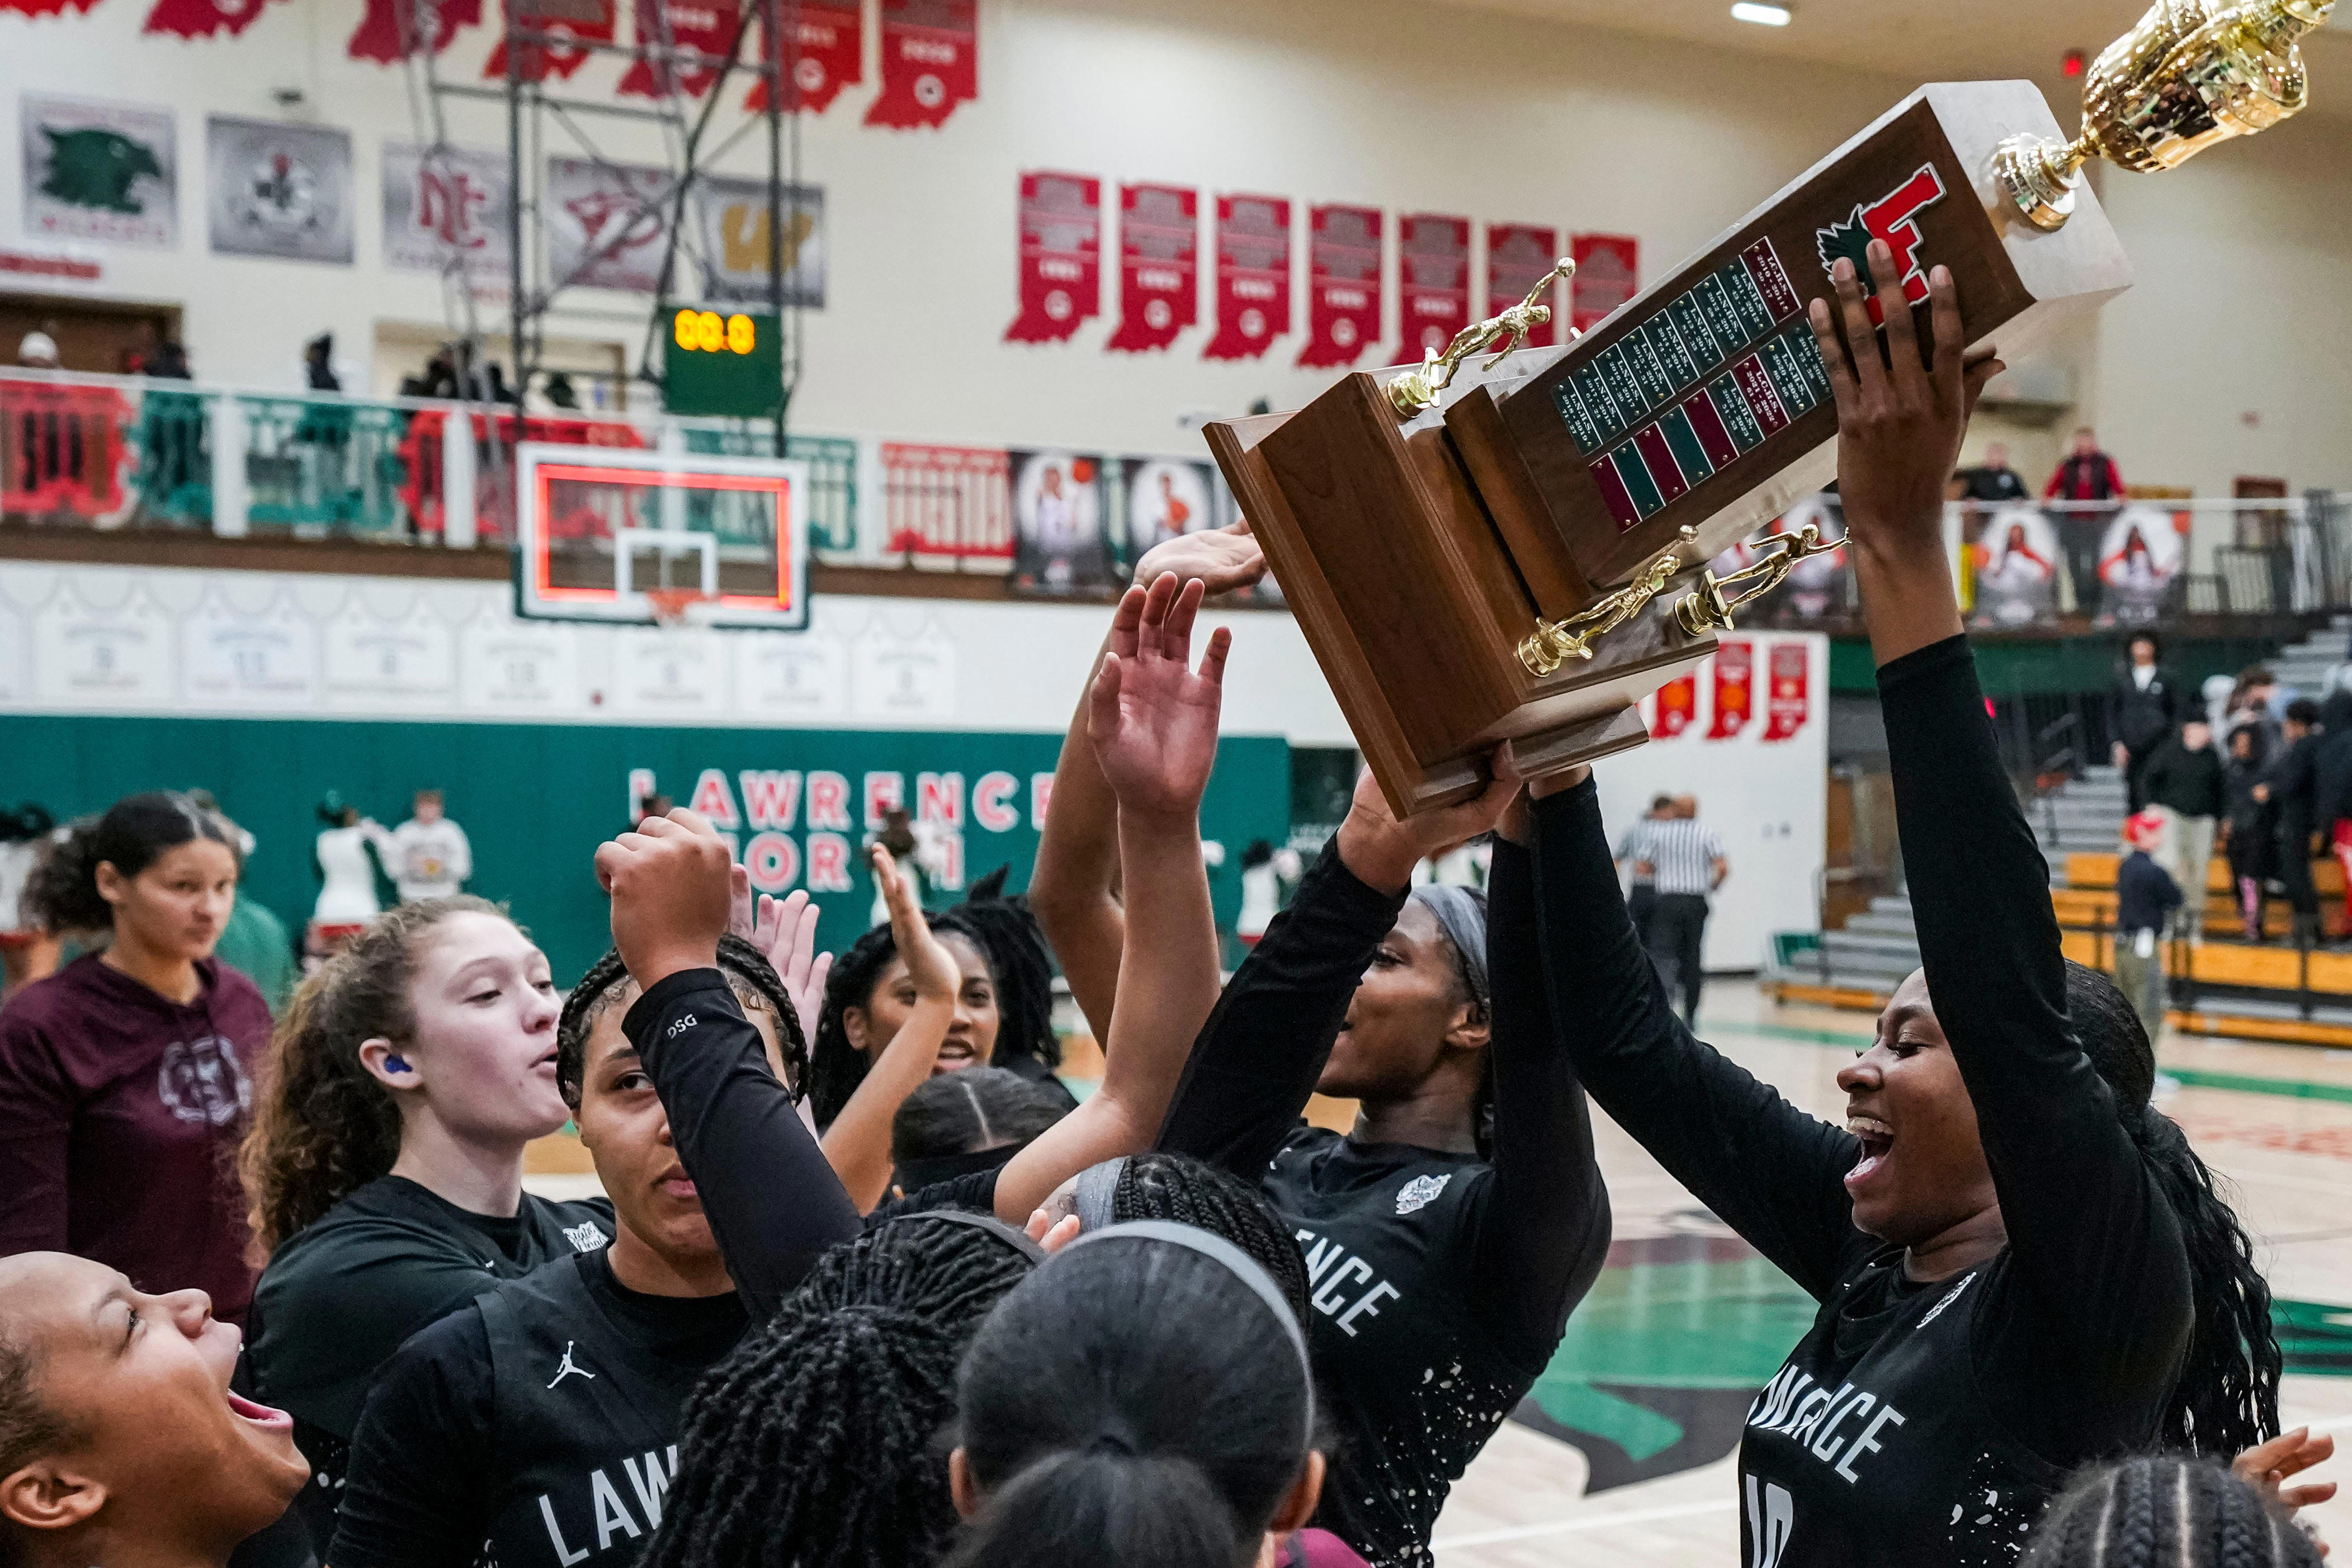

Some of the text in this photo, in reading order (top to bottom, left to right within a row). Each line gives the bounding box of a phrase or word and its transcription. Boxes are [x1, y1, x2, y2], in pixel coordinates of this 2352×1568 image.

[1732, 274, 1744, 293] 2011
[1745, 301, 1759, 323] 2012
[1757, 254, 1770, 277] 2010
[1772, 284, 1784, 305] 2011
[1682, 309, 1694, 329] 2013
[1695, 336, 1708, 357] 2014
[1707, 292, 1720, 311] 2012
[1721, 318, 1734, 339] 2013
[1633, 344, 1645, 363] 2015
[1646, 370, 1659, 391] 2016
[1641, 343, 1664, 384] L.N.H.S.
[1657, 327, 1669, 346] 2014
[1671, 353, 1684, 374] 2015
[1665, 325, 1688, 367] L.N.H.S.
[1798, 337, 1811, 356] 2019
[1812, 363, 1826, 384] 2020
[1594, 377, 1616, 417] L.N.H.S.
[1609, 361, 1621, 380] 2016
[1622, 387, 1635, 407] 2017
[1617, 360, 1639, 400] L.N.H.S.
[1746, 371, 1760, 393] 2021
[1760, 399, 1774, 421] 2022
[1756, 370, 1778, 412] L.C.H.S.
[1772, 354, 1786, 375] 2020
[1787, 382, 1801, 404] 2021
[1782, 353, 1805, 395] L.N.H.S.
[1562, 394, 1574, 413] 2018
[1575, 419, 1587, 441] 2019
[1570, 393, 1591, 433] L.N.H.S.
[1586, 378, 1597, 396] 2017
[1599, 404, 1612, 424] 2018
[1722, 389, 1734, 408] 2022
[1736, 415, 1749, 436] 2023
[1730, 387, 1753, 429] L.N.H.S.
[667, 1013, 698, 1039] DSG
[1295, 1229, 1401, 1337] NCE
